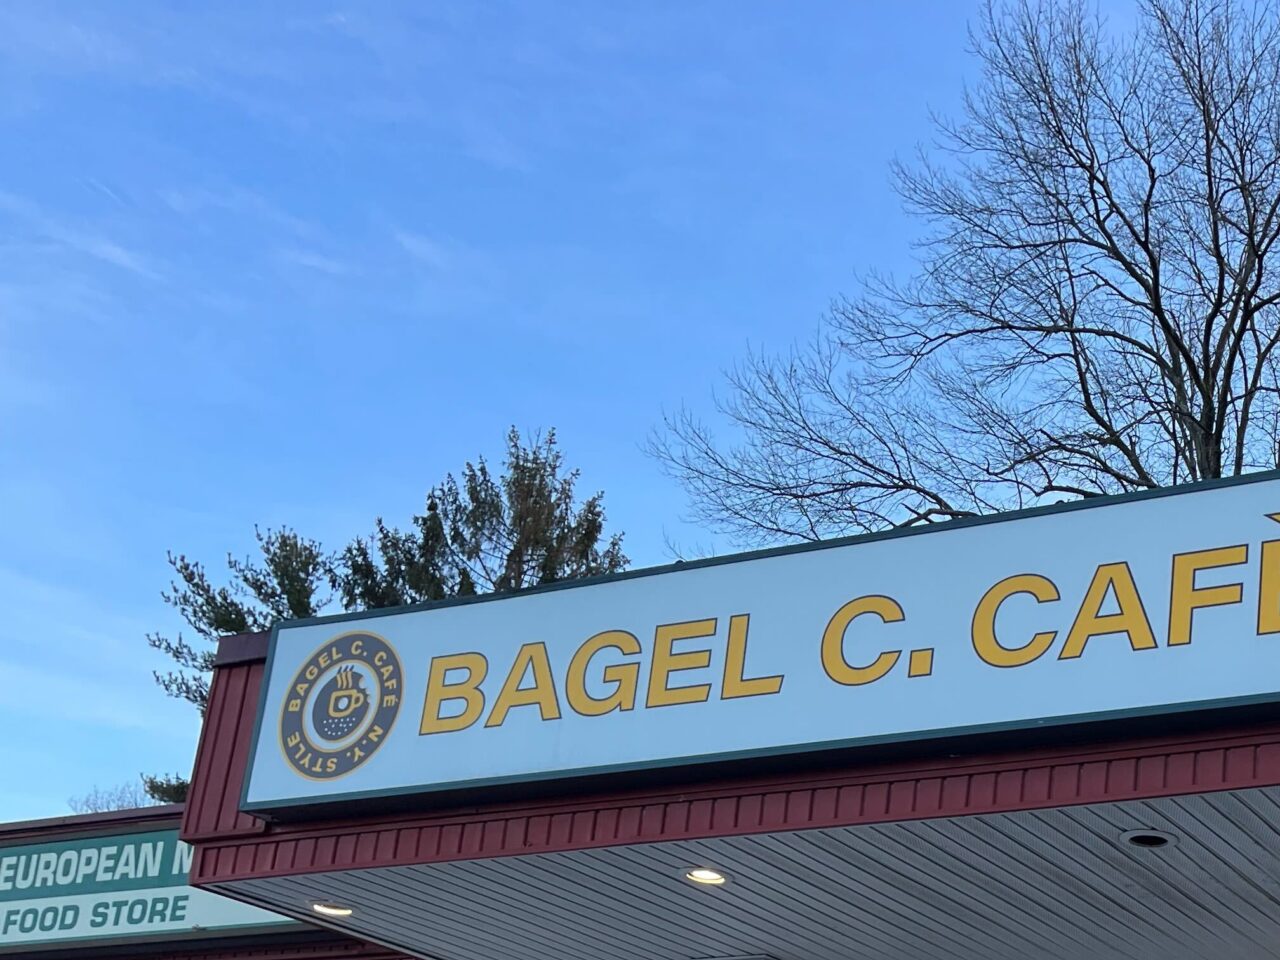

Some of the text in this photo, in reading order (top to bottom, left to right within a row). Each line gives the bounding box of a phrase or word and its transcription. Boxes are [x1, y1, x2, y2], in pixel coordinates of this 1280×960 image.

[289, 646, 343, 712] BAGEL
[418, 613, 785, 736] BAGEL
[820, 594, 935, 687] C.
[287, 725, 384, 772] N.Y. STYLE
[0, 841, 164, 890] EUROPEAN
[2, 895, 189, 935] FOOD STORE
